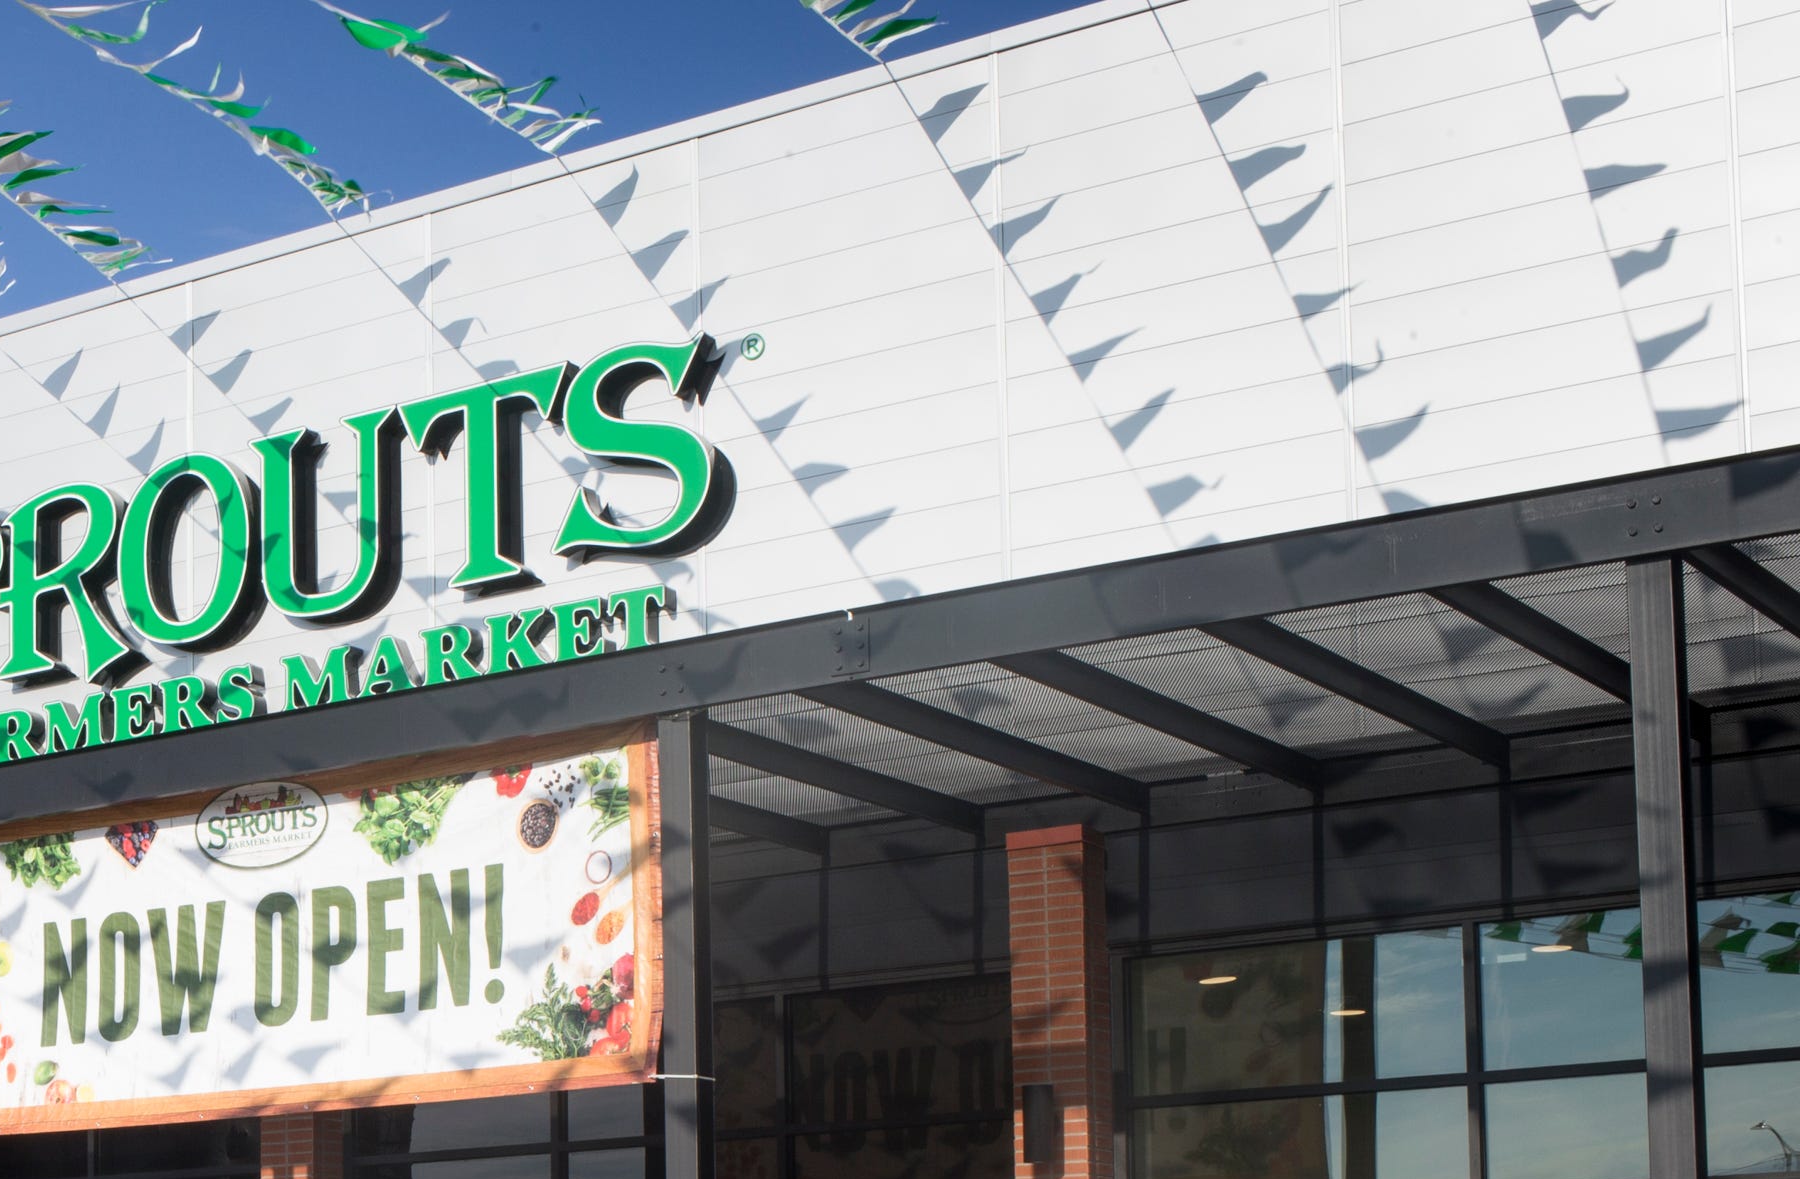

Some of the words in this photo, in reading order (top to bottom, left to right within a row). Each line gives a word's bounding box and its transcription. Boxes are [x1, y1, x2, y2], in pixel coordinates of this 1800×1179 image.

[282, 586, 668, 708] MARKET
[207, 805, 318, 850] SPROUTS
[228, 837, 271, 850] FARMERS
[272, 831, 313, 845] MARKET
[41, 900, 226, 1048] NOW
[254, 863, 505, 1029] OPEN!
